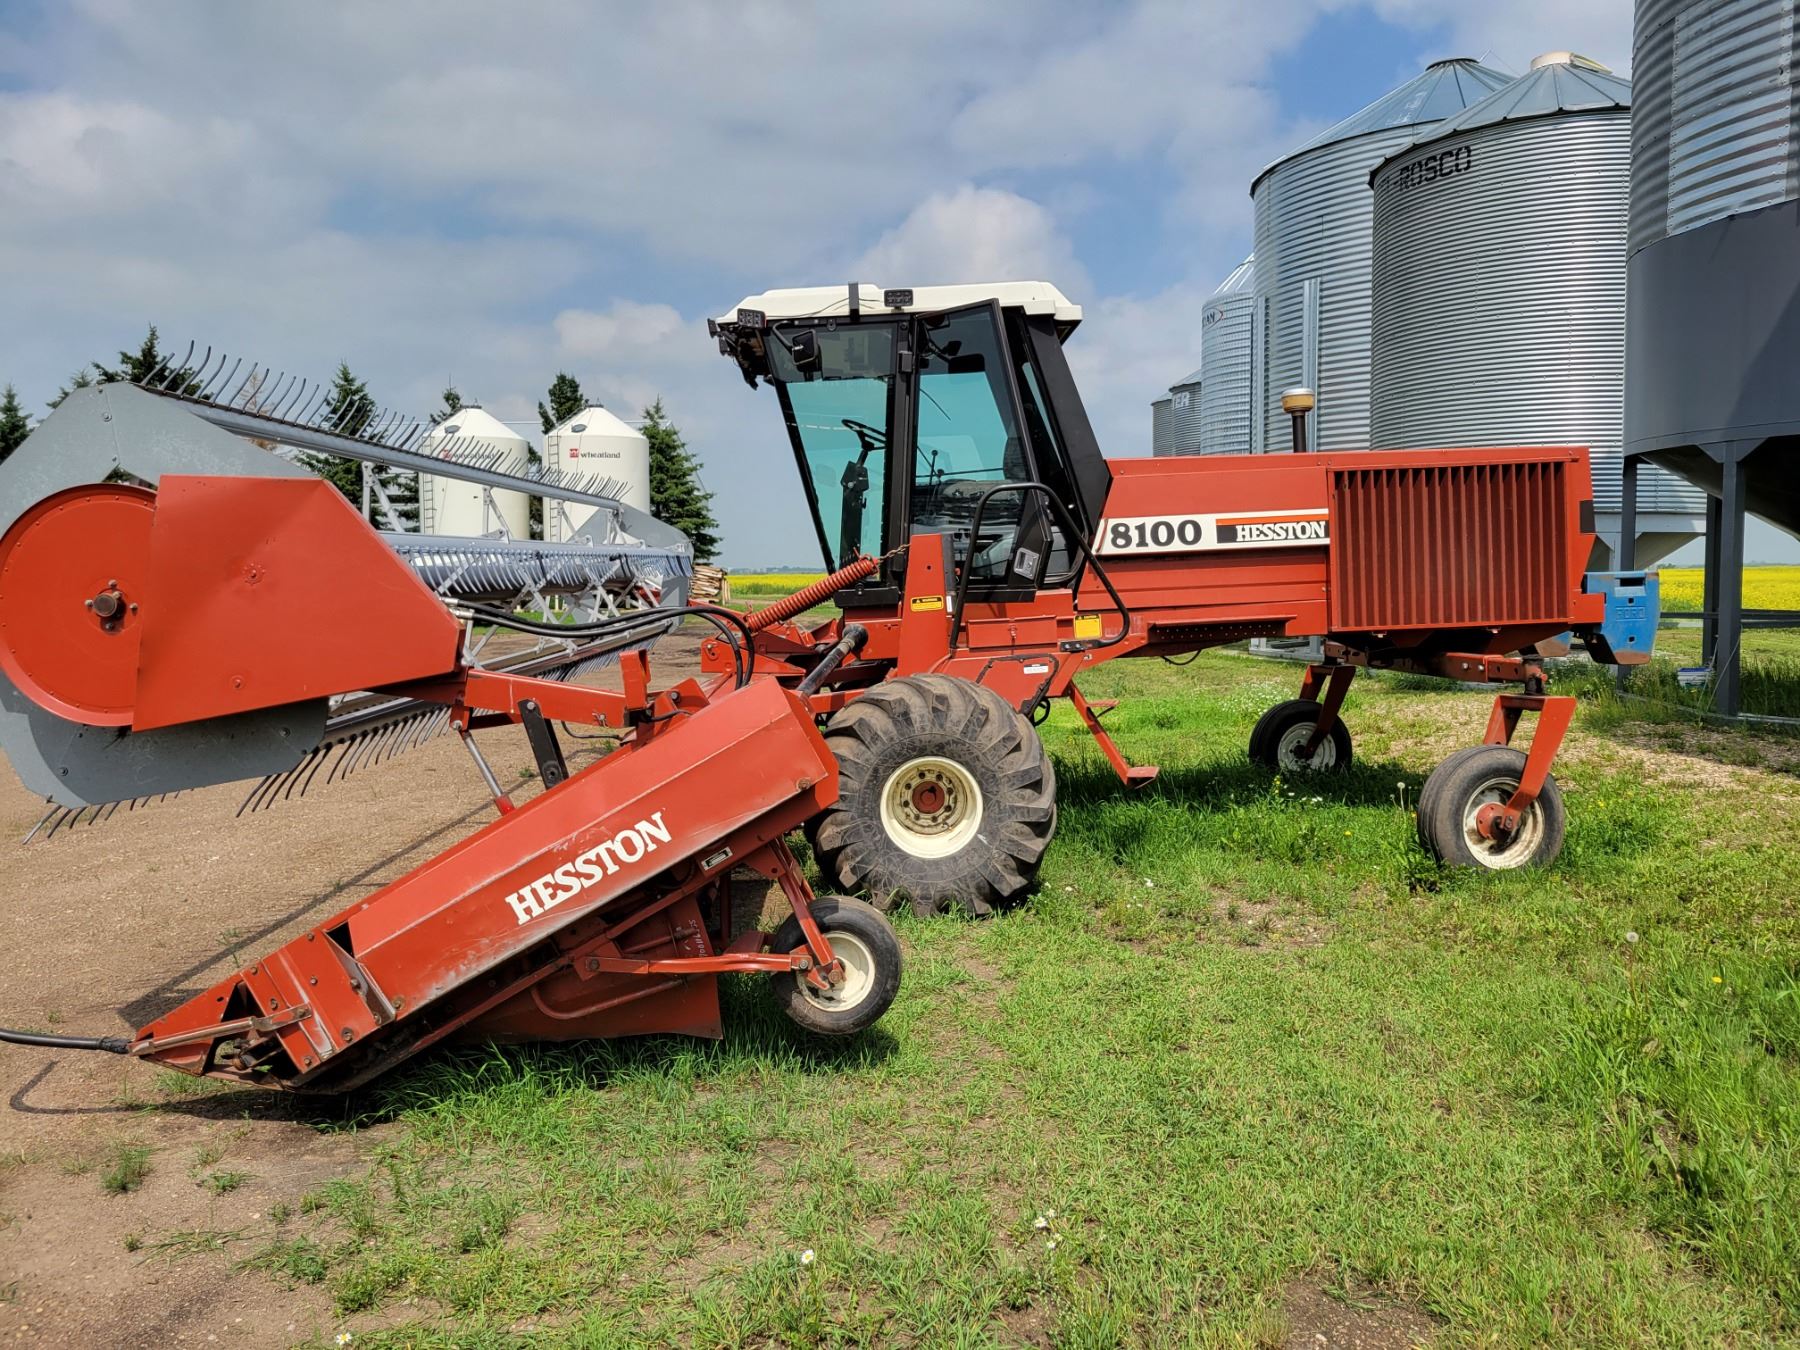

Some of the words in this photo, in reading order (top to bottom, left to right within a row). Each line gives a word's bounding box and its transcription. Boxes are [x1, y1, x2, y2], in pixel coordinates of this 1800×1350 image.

[580, 451, 621, 459] wheatland
[1110, 519, 1202, 549] 8100
[1235, 520, 1326, 542] HESSTON
[505, 811, 672, 925] HESSTON
